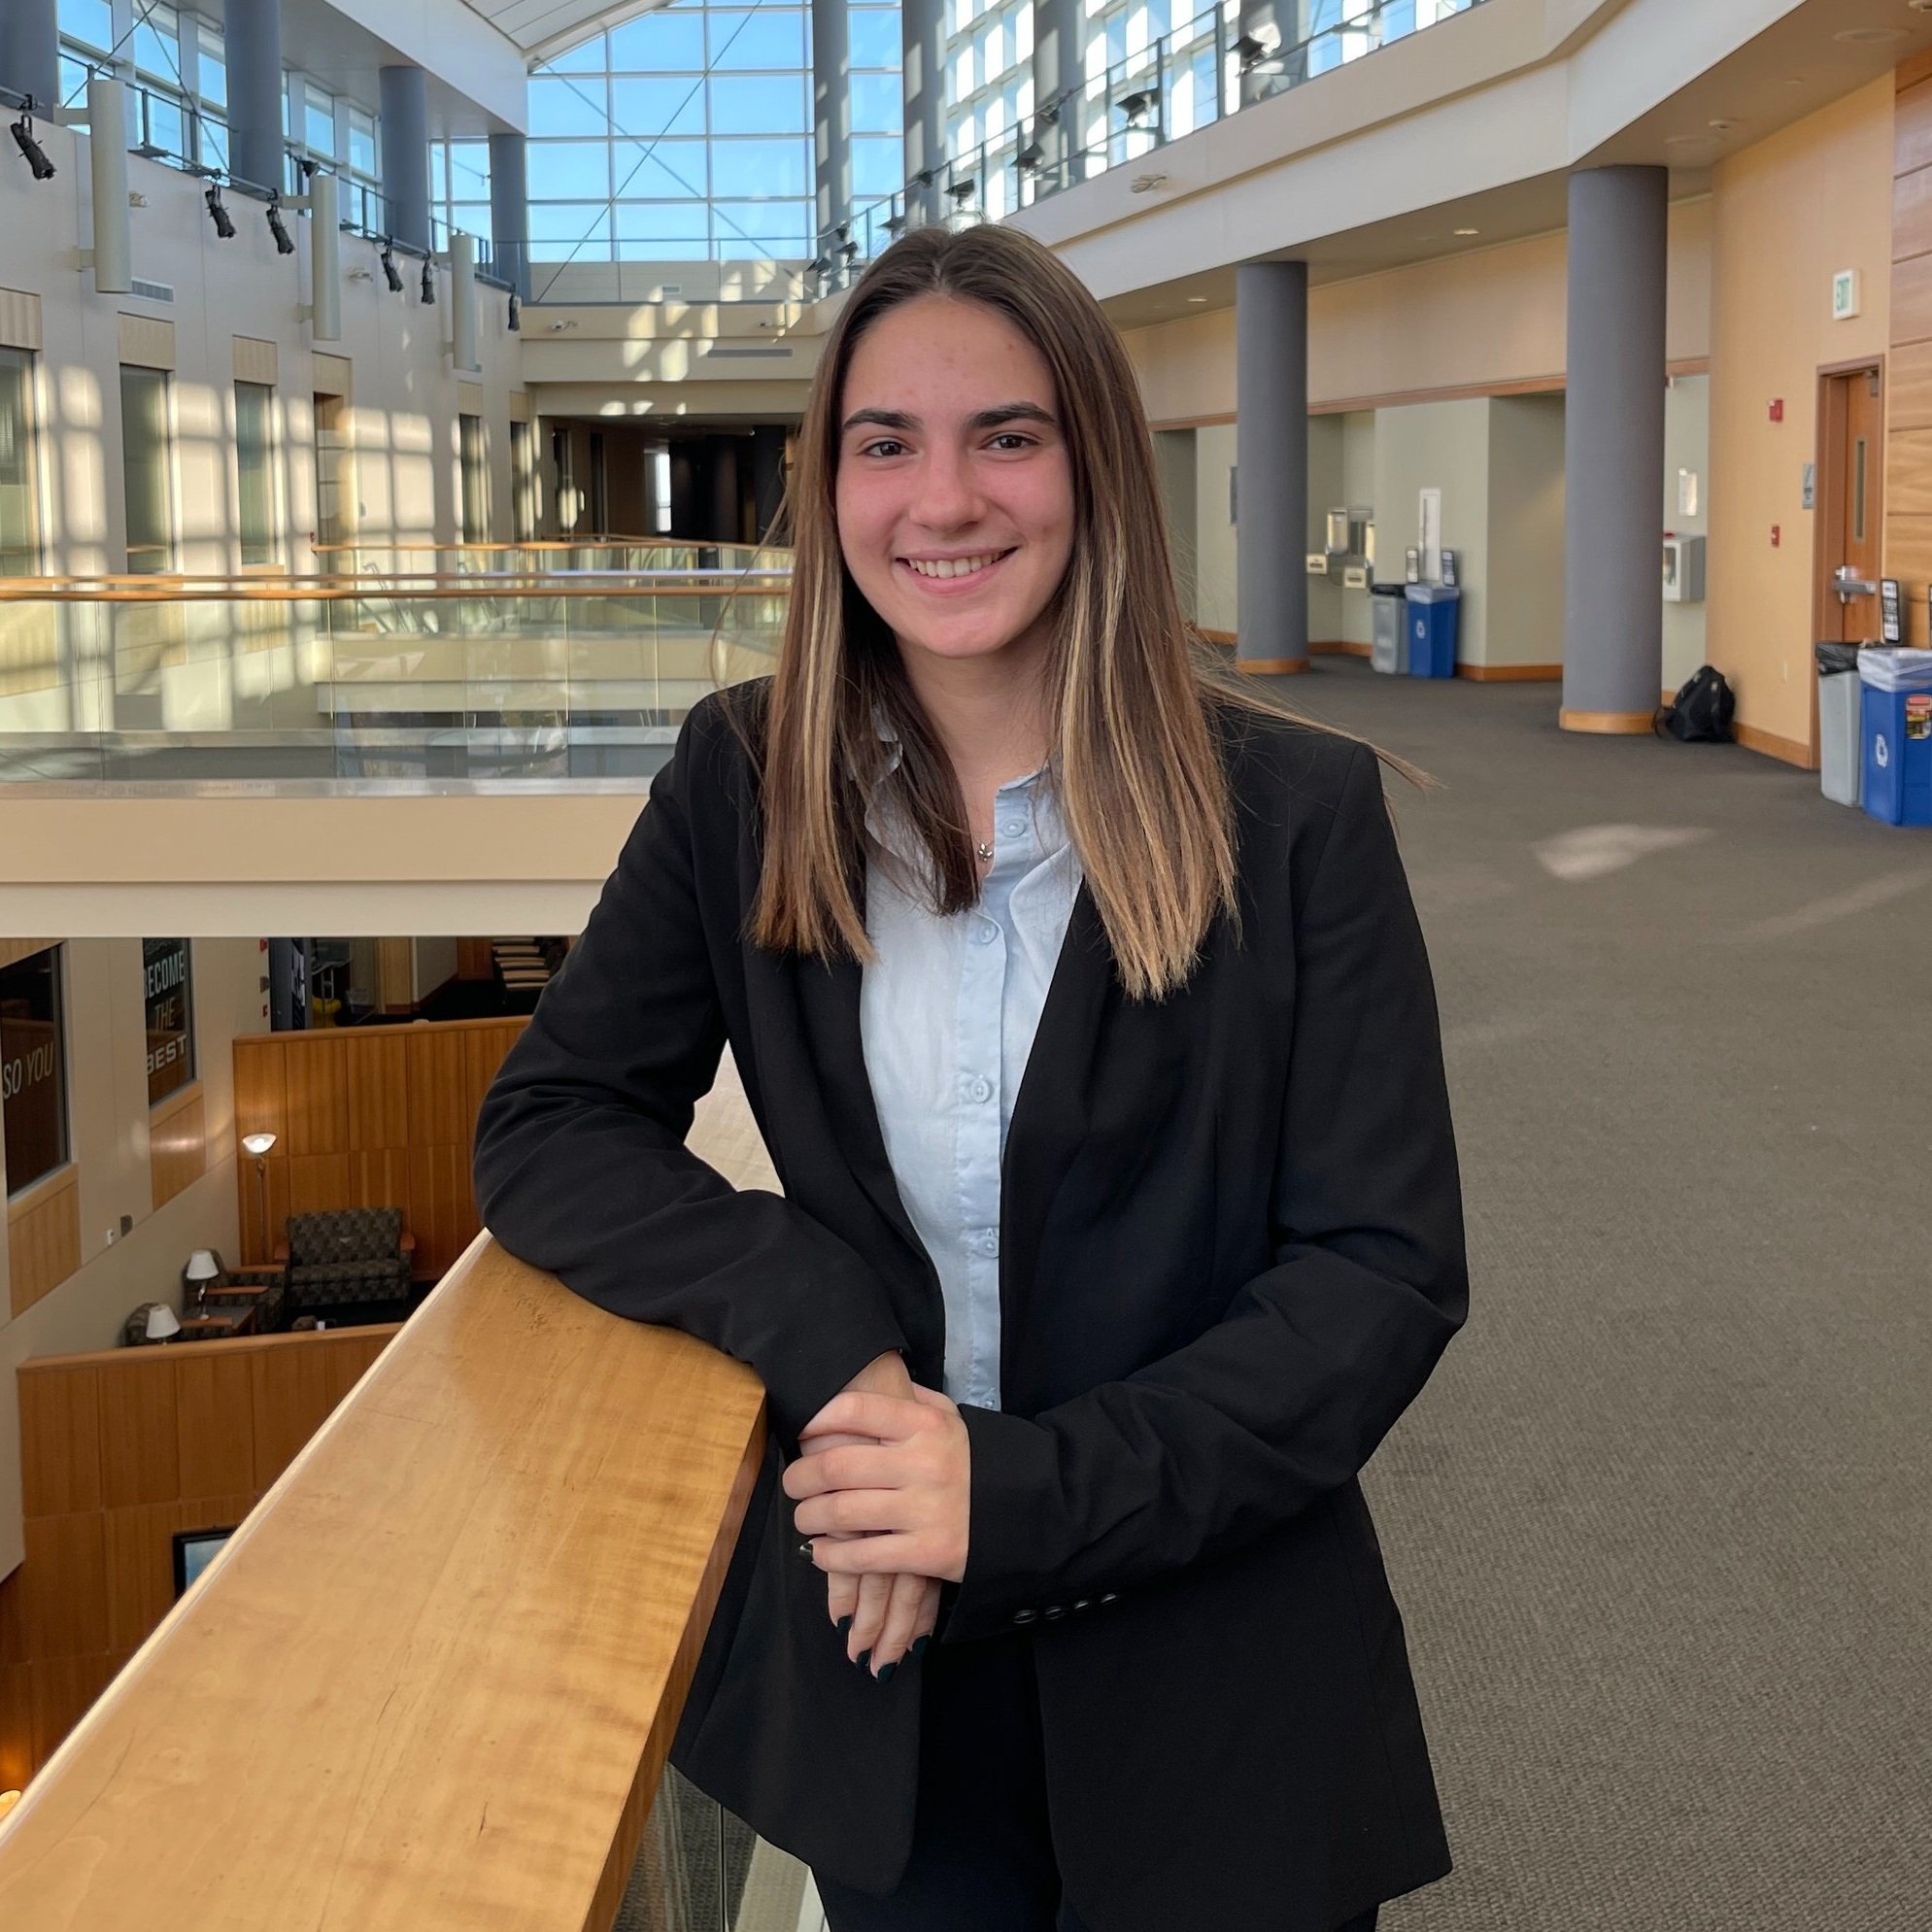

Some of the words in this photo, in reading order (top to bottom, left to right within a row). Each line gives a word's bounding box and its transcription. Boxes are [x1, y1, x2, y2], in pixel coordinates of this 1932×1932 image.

[155, 997, 176, 1033] THE
[3, 1058, 22, 1100] SO
[26, 1041, 54, 1087] YOU
[148, 1034, 187, 1075] BEST
